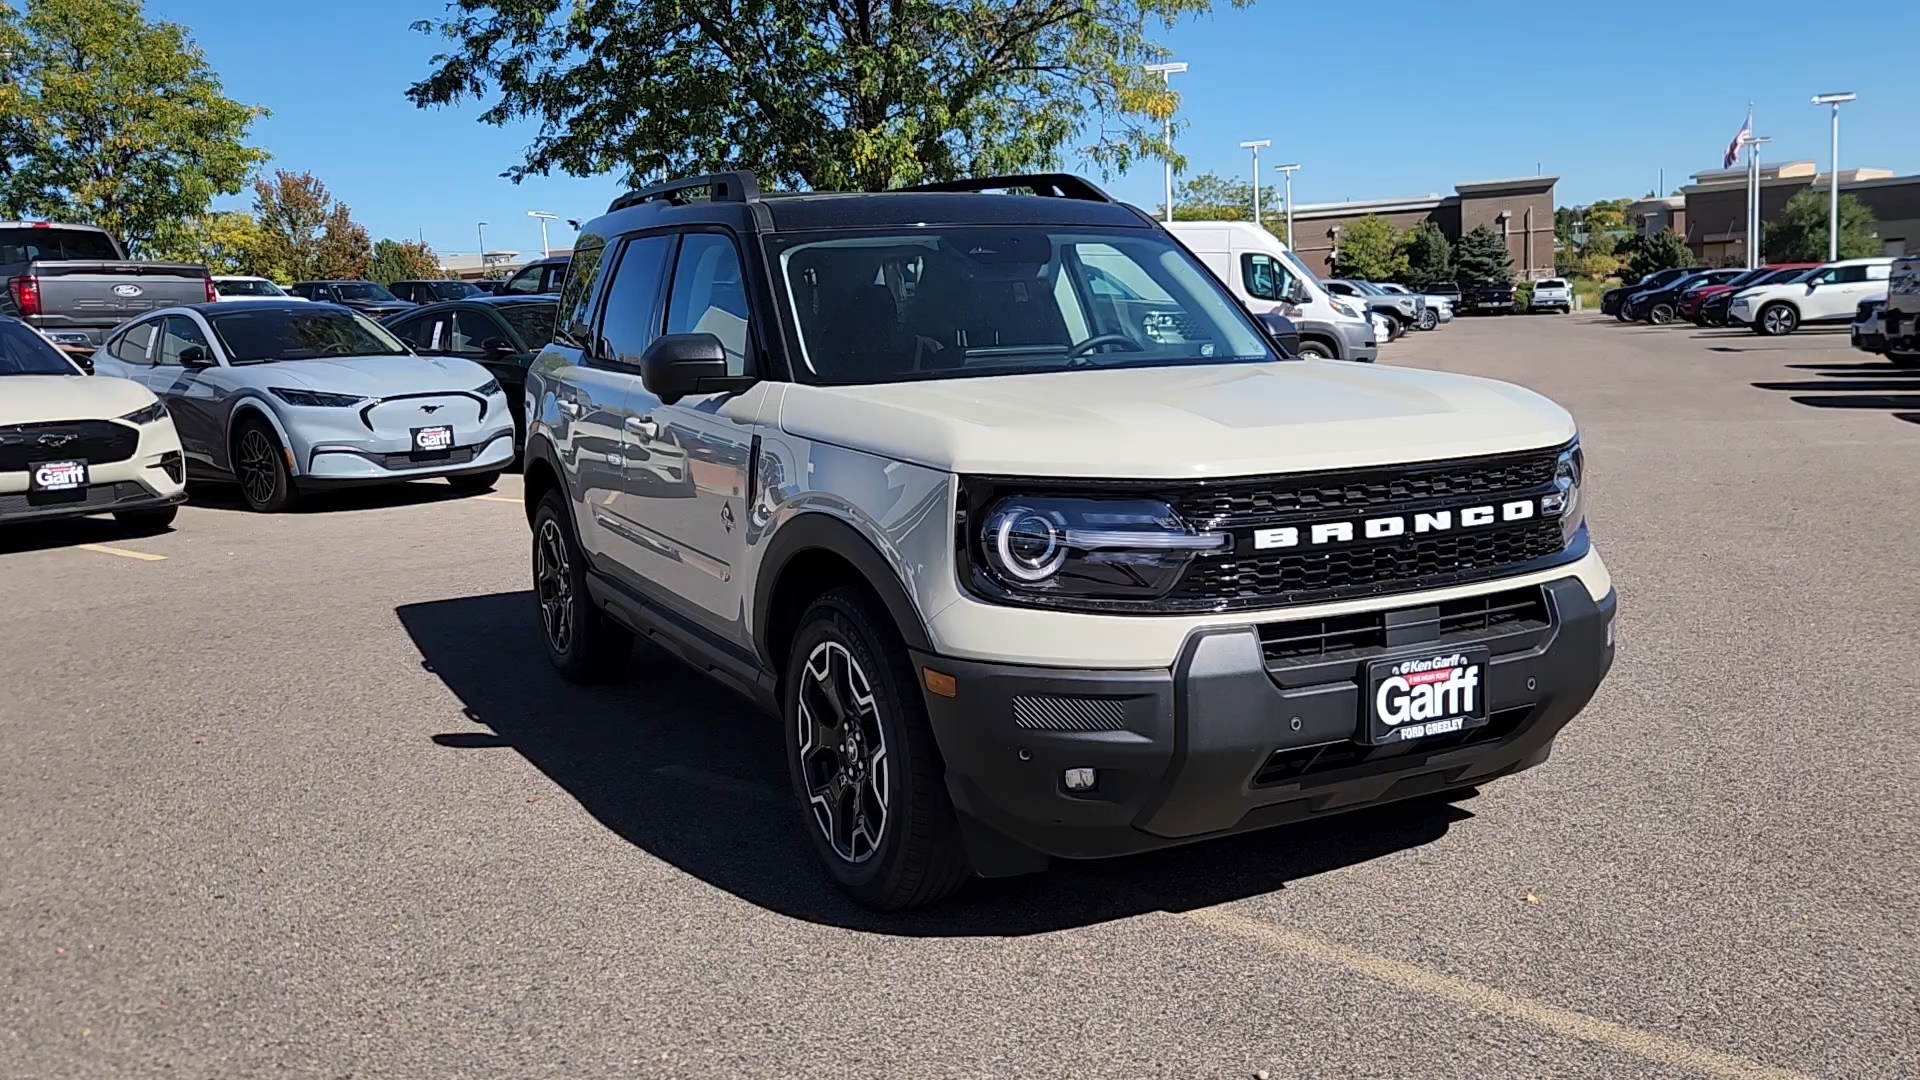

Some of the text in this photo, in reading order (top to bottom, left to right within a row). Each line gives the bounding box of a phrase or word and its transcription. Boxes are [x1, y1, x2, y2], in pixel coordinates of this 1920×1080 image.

[416, 430, 451, 447] Garff
[36, 465, 84, 486] Garff
[1253, 499, 1535, 550] BRONCO
[1410, 653, 1460, 673] Ken Garff
[1376, 665, 1479, 726] Garff
[1401, 718, 1464, 740] FORD GREELEY
